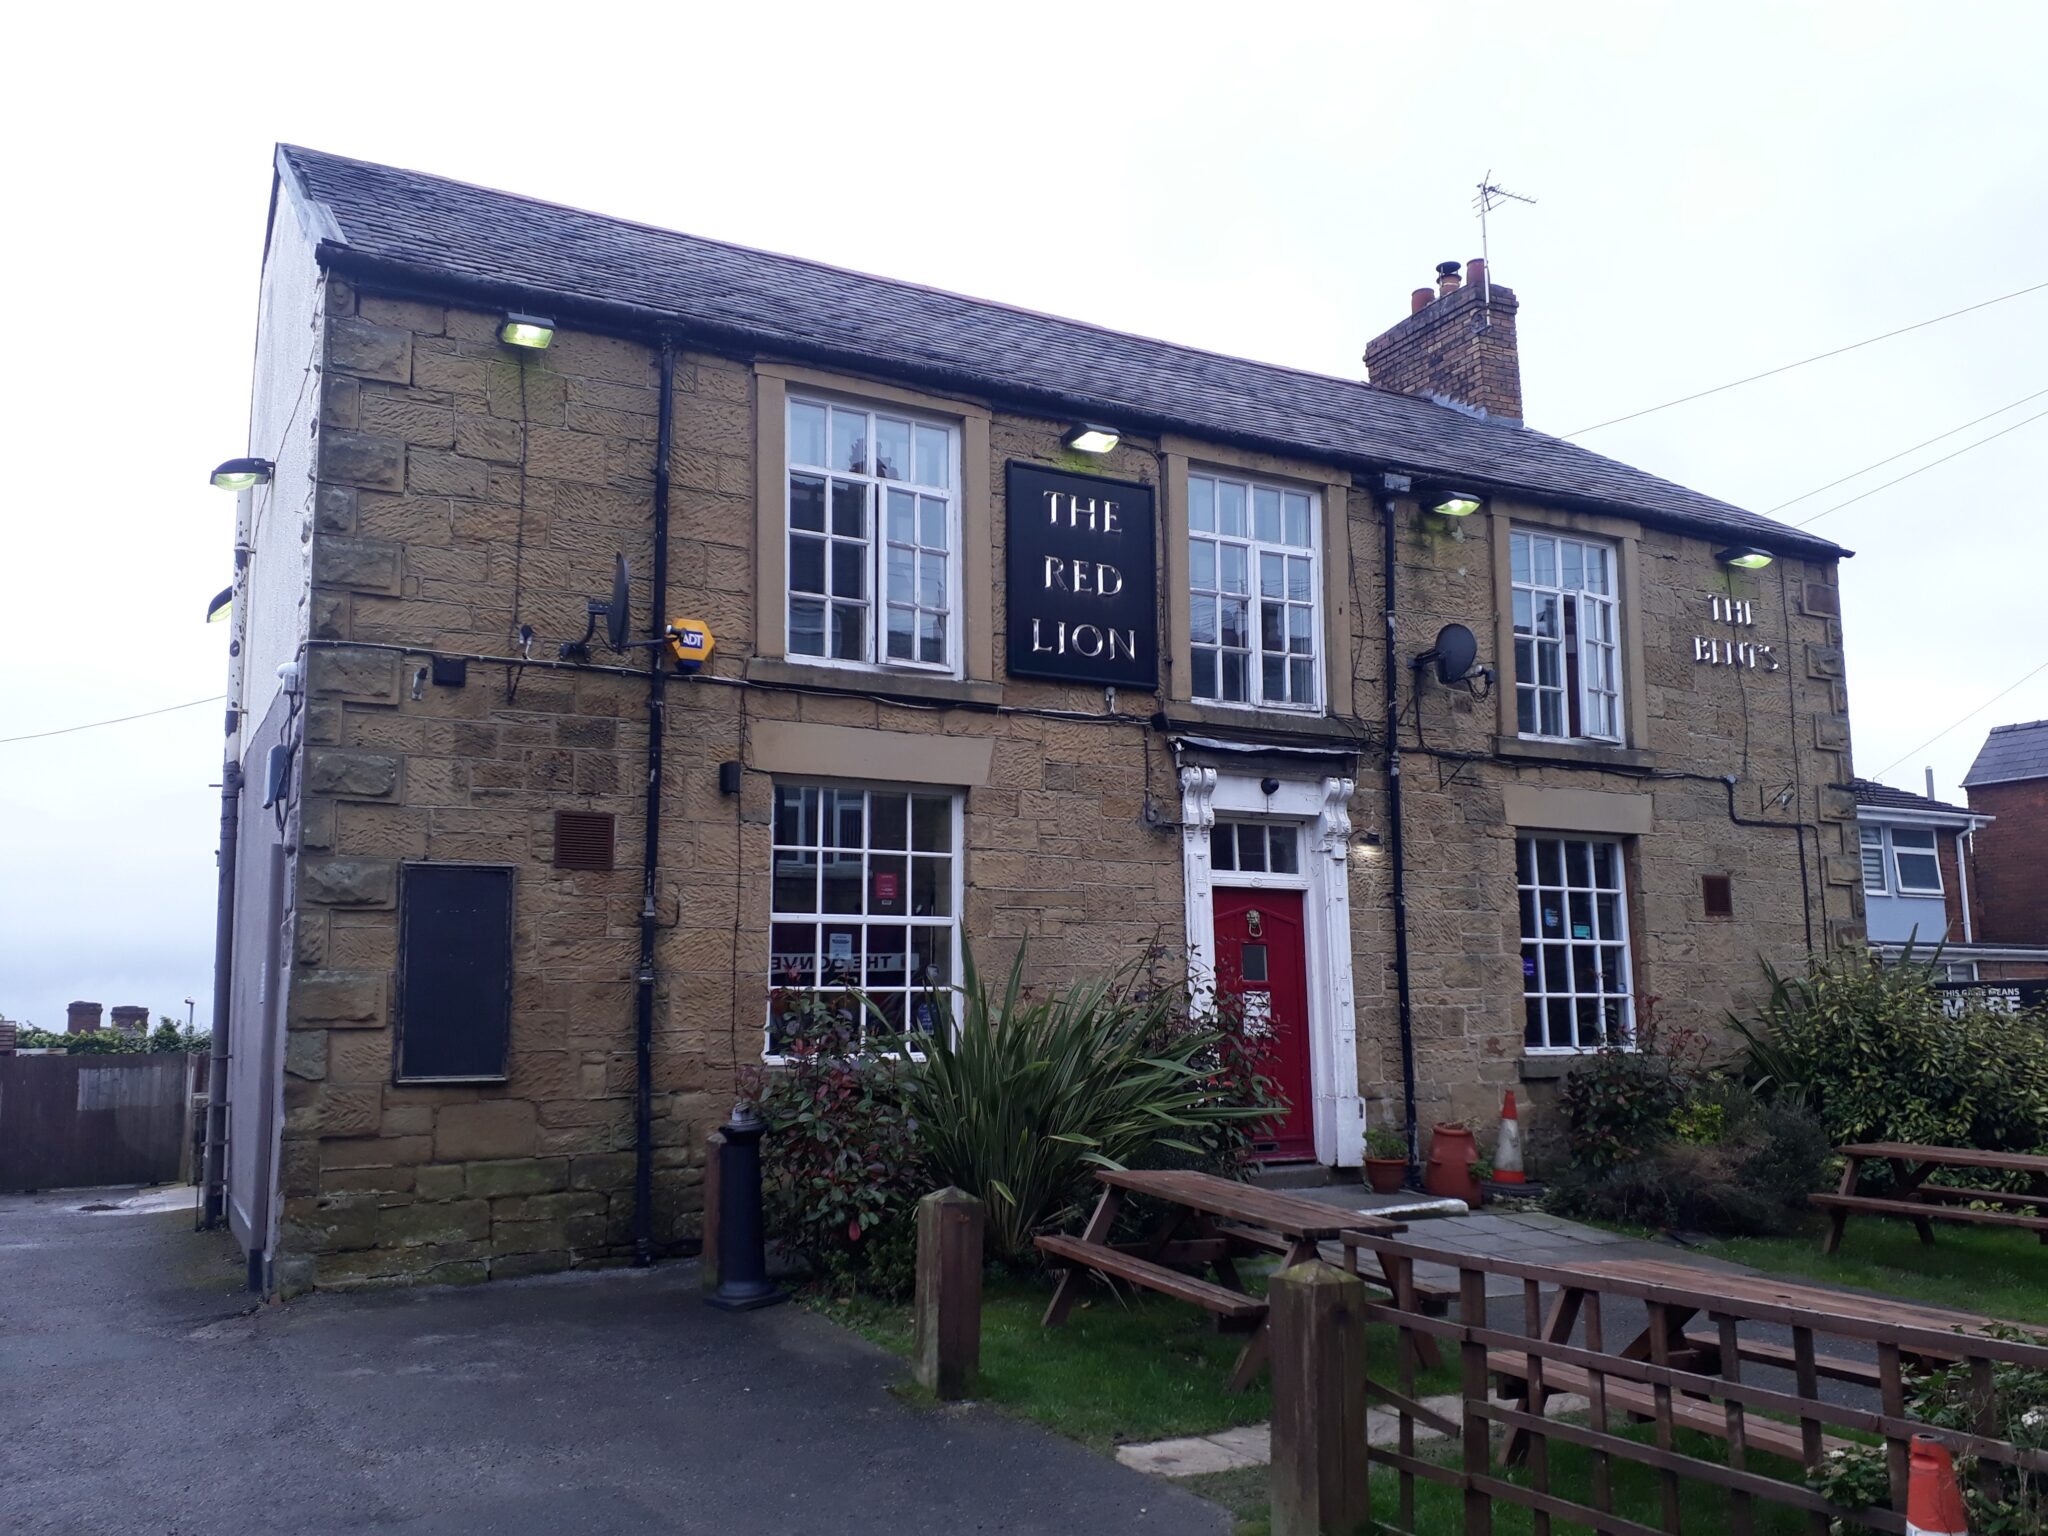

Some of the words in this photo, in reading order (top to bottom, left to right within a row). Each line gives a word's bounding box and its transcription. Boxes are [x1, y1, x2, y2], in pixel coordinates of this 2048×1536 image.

[1043, 490, 1123, 533] THE
[1044, 555, 1123, 596] RED
[683, 633, 703, 647] ADT
[1032, 618, 1136, 663] LION
[1942, 989, 1960, 998] THIS
[1942, 996, 2020, 1018] MRE
